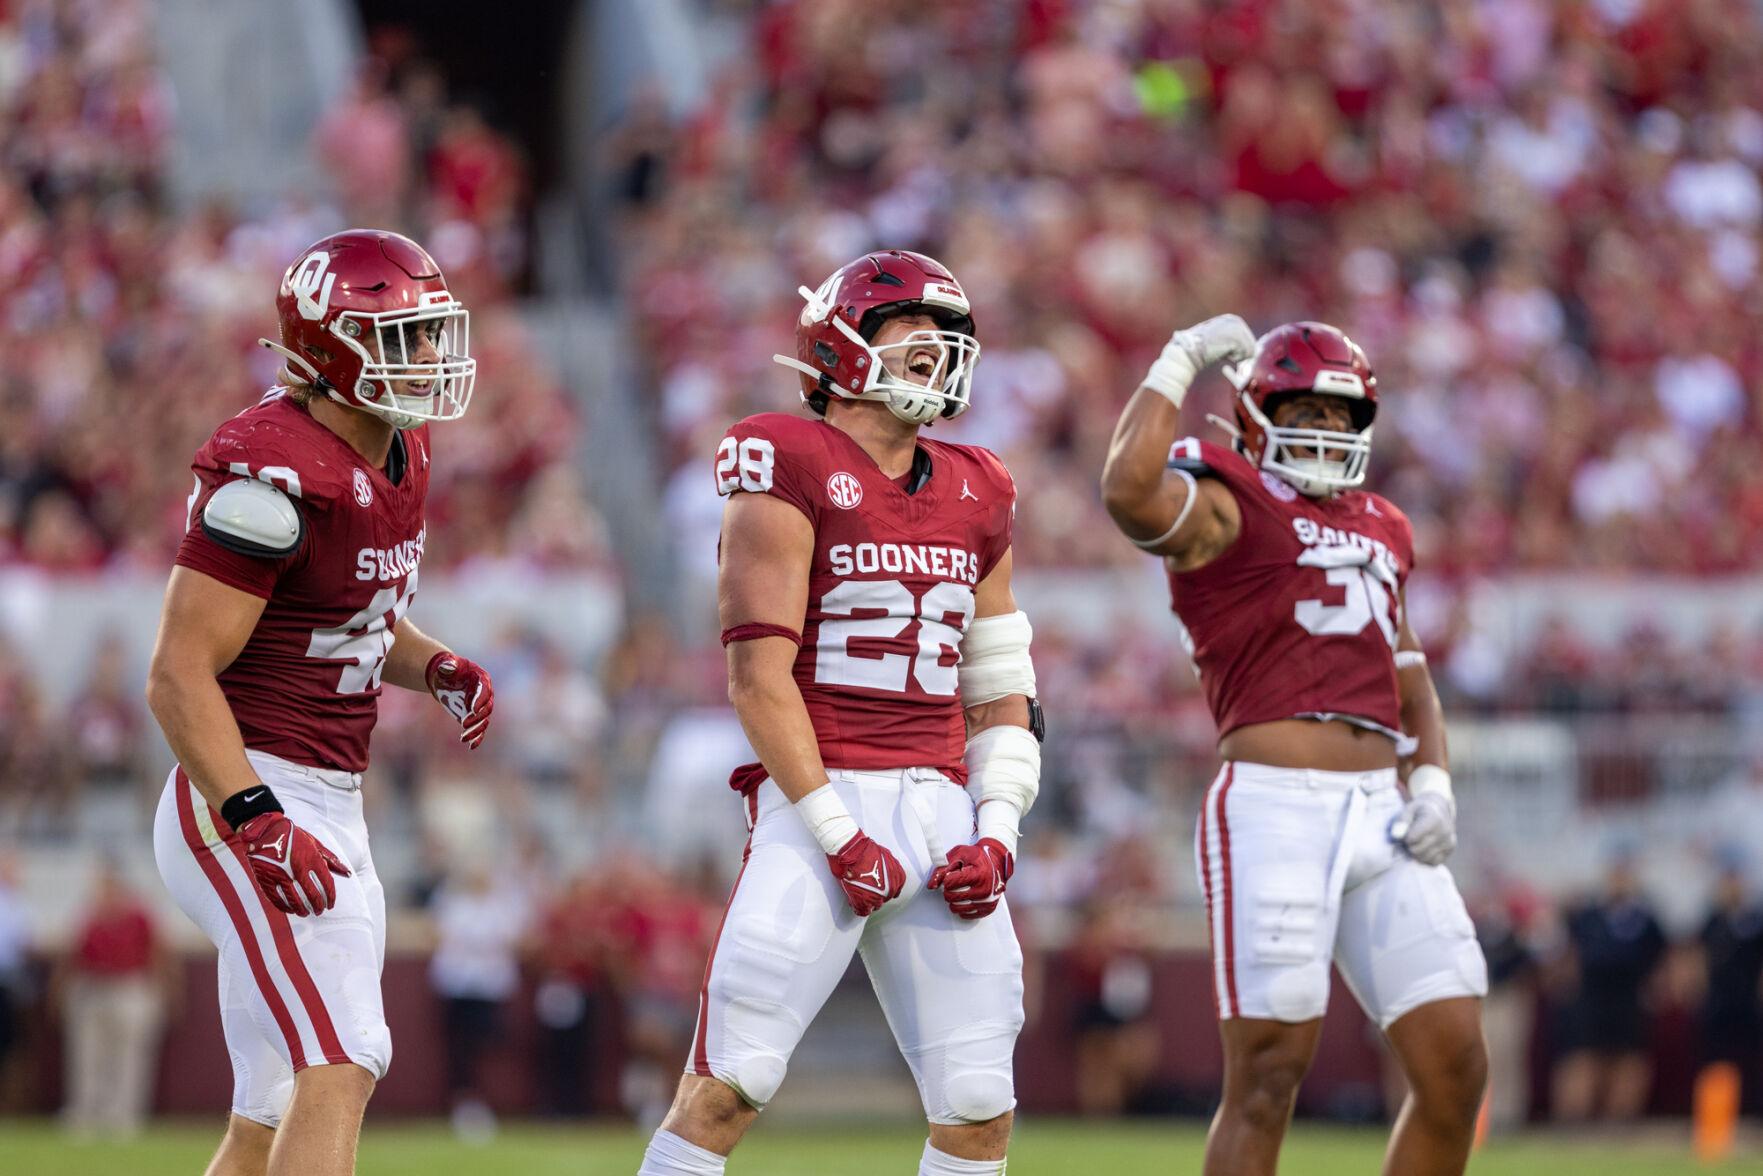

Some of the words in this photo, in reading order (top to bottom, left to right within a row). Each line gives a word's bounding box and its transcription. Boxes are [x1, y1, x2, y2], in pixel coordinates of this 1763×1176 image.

[716, 437, 775, 496] 28
[829, 473, 861, 508] SEC
[829, 543, 978, 585] SOONERS
[814, 580, 976, 696] 28
